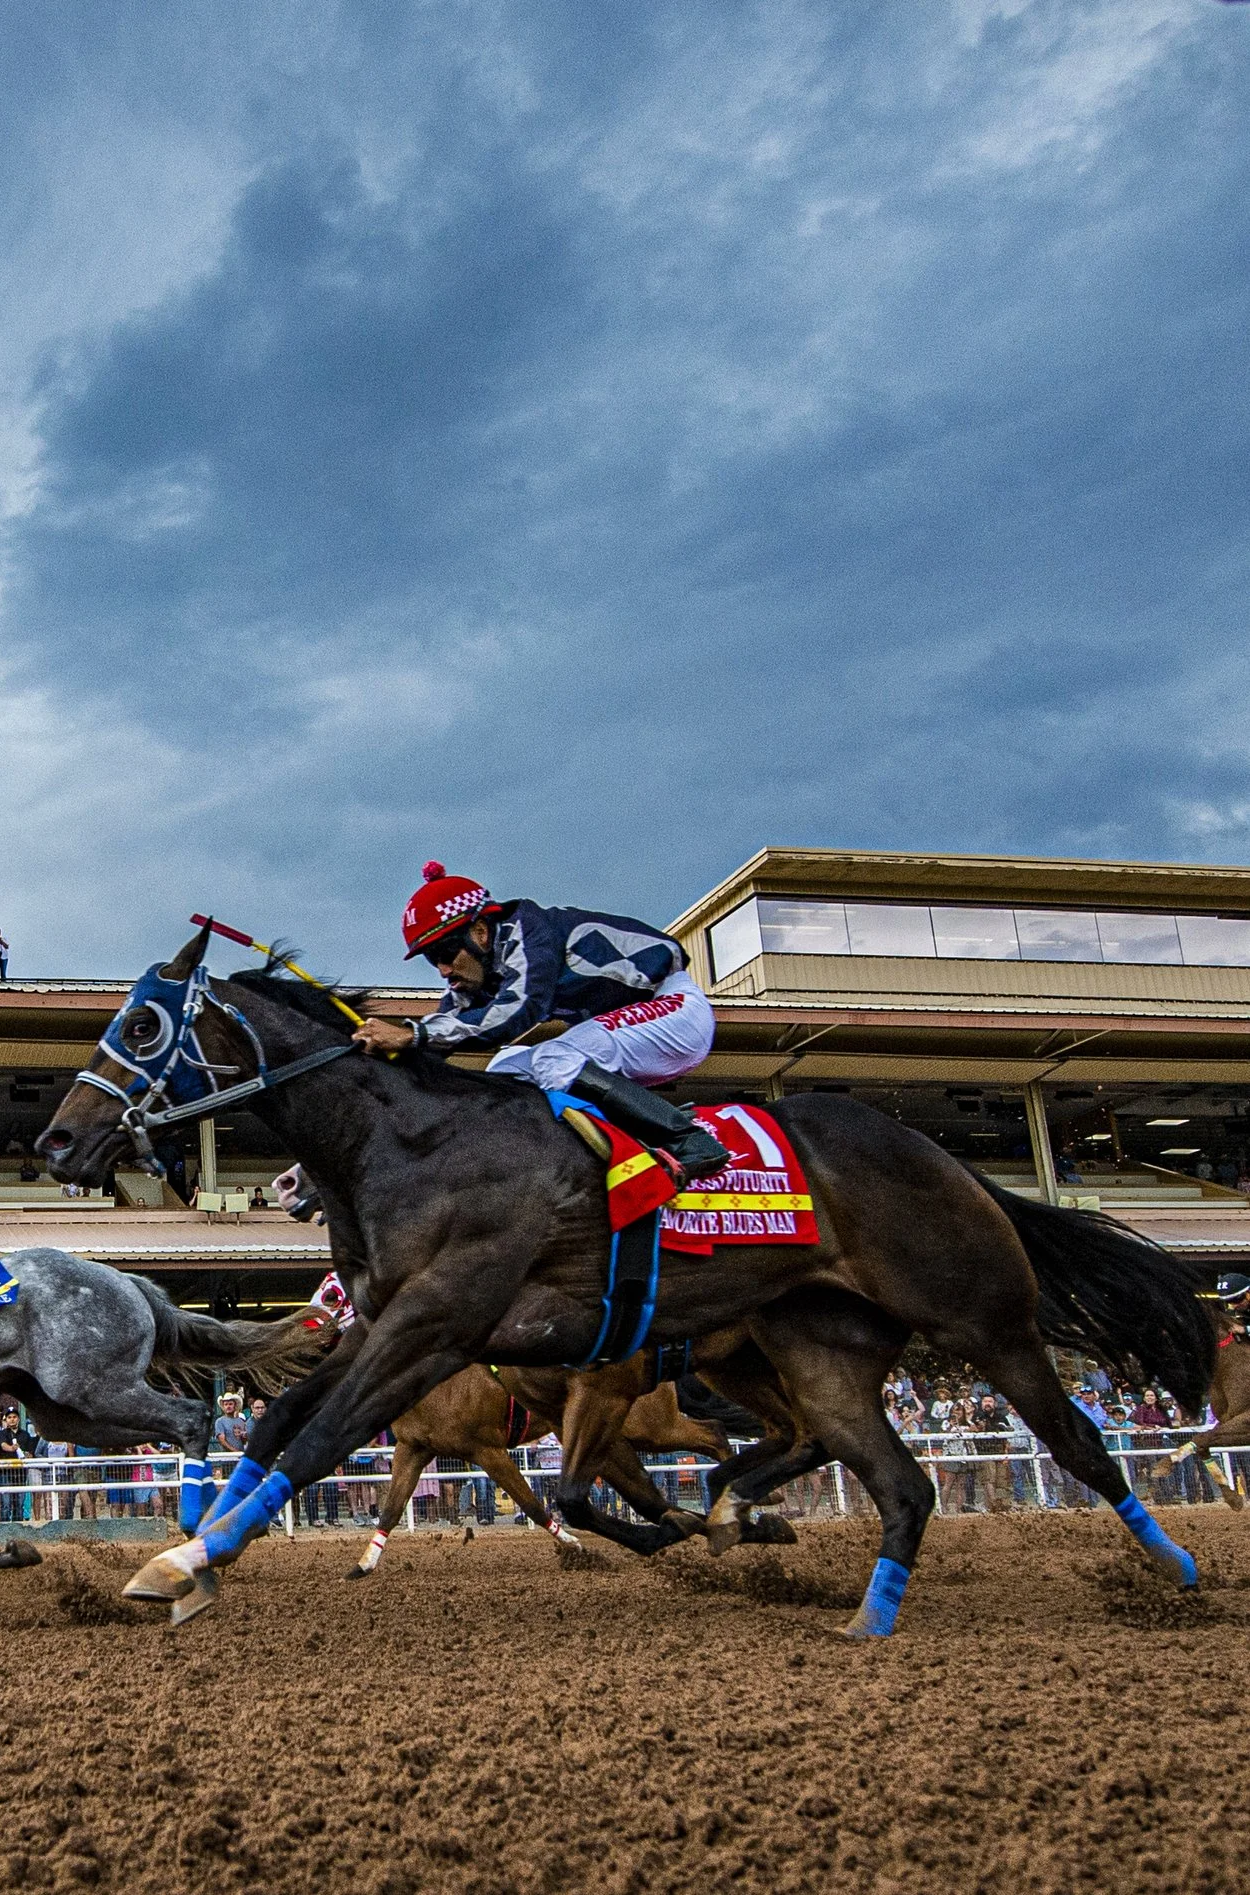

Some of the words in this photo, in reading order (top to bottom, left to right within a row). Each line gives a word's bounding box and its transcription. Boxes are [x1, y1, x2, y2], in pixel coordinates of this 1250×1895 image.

[714, 1105, 786, 1168] 1
[724, 1169, 792, 1193] FUTURITY
[659, 1207, 720, 1235] AVORITE
[721, 1211, 765, 1235] BLUES
[765, 1212, 797, 1235] MAN
